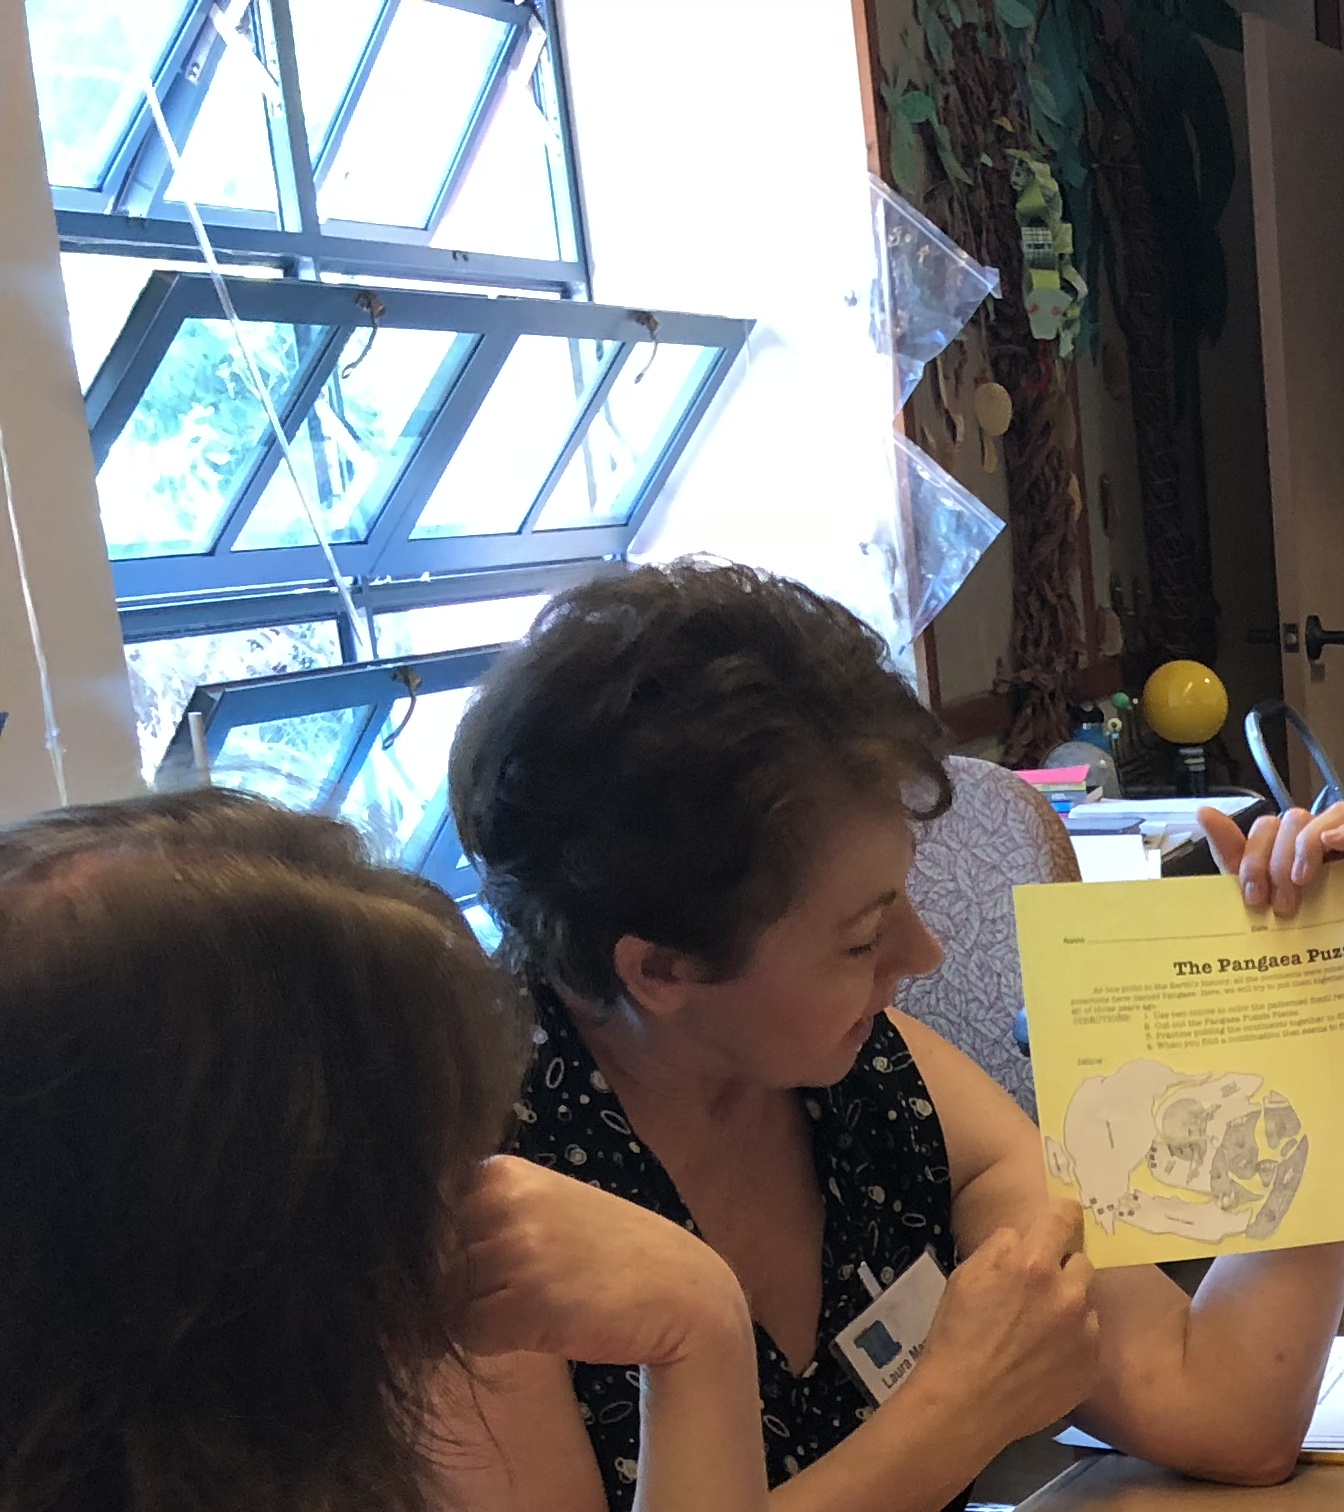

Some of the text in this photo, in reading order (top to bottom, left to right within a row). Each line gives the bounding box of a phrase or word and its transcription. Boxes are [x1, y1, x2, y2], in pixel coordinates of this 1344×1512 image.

[1173, 962, 1213, 976] The
[1217, 953, 1303, 972] Pangaea
[881, 1358, 912, 1389] Laura
